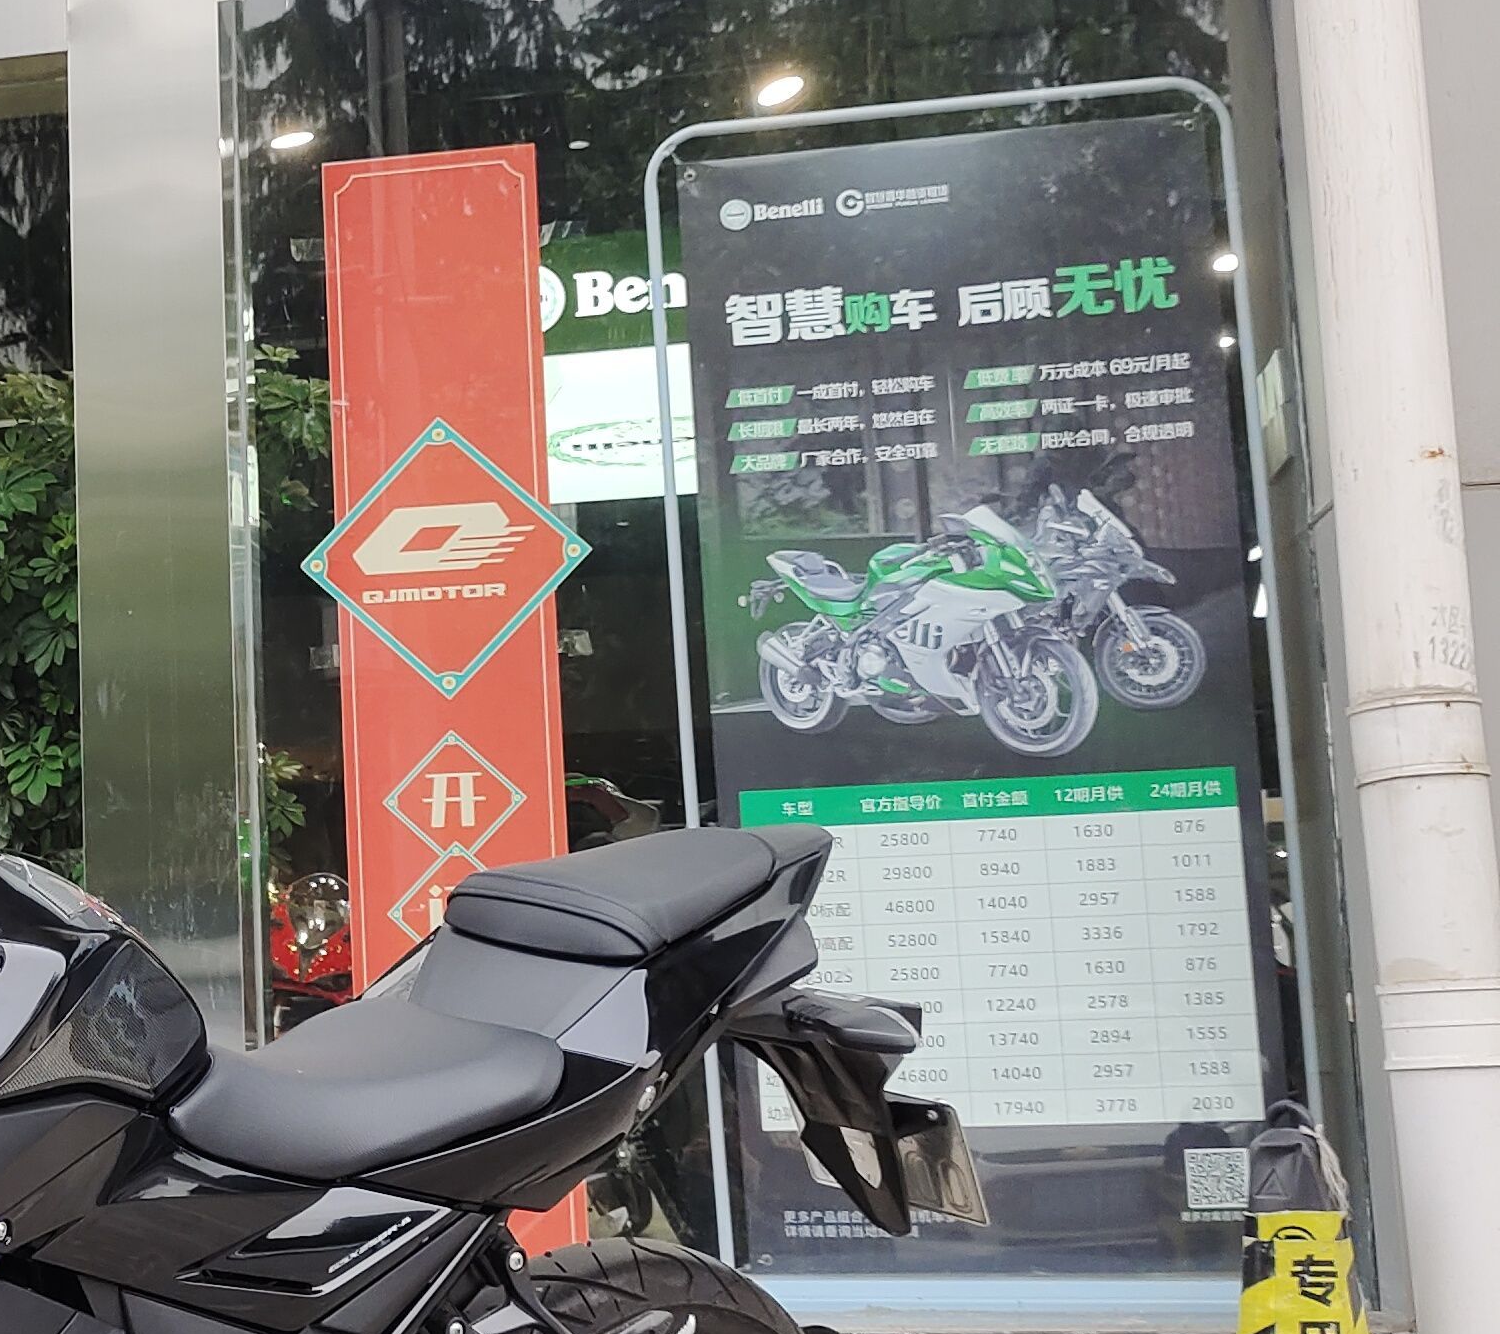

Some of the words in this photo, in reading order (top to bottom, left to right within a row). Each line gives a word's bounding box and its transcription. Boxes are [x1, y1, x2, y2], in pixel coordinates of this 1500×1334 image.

[752, 197, 825, 222] Benelli
[724, 285, 939, 347] 智慧购车
[957, 256, 1180, 327] 后顾无忧
[737, 387, 783, 405] 低首付
[740, 454, 788, 472] 大品牌
[361, 582, 508, 605] QJMOTOR
[781, 800, 814, 817] 车型
[859, 794, 943, 813] 官方指导价
[961, 789, 1029, 809] 首付金额
[1053, 785, 1125, 803] 12期月供
[1149, 780, 1223, 799] 24期月供
[880, 832, 930, 847] 25800
[977, 827, 1018, 842] 7740
[1072, 823, 1113, 838] 1630
[1173, 818, 1206, 834] 876
[882, 865, 932, 881] 29800
[980, 861, 1021, 876] 8940
[1076, 857, 1117, 872] 1883
[1171, 853, 1212, 868] 1011
[884, 899, 935, 914] 46800
[977, 895, 1028, 909] 14040
[1079, 891, 1120, 906] 2957
[1174, 887, 1216, 902] 1588
[887, 933, 938, 948] 52800
[980, 929, 1031, 944] 15840
[1081, 925, 1123, 940] 3336
[1177, 922, 1219, 937] 1792
[890, 966, 940, 981] 25800
[987, 963, 1029, 978] 7740
[1085, 960, 1126, 975] 1630
[1185, 957, 1217, 972] 876
[986, 997, 1037, 1012] 12240
[1087, 994, 1129, 1009] 2578
[1183, 991, 1225, 1006] 1385
[989, 1031, 1039, 1046] 13740
[1090, 1028, 1131, 1044] 2894
[1186, 1025, 1228, 1040] 1555
[897, 1068, 948, 1083] 46800
[991, 1066, 1042, 1081] 14040
[1093, 1063, 1133, 1079] 2957
[1188, 1060, 1231, 1076] 1588
[995, 1099, 1045, 1115] 17940
[1096, 1098, 1138, 1113] 3778
[1192, 1095, 1234, 1111] 2030
